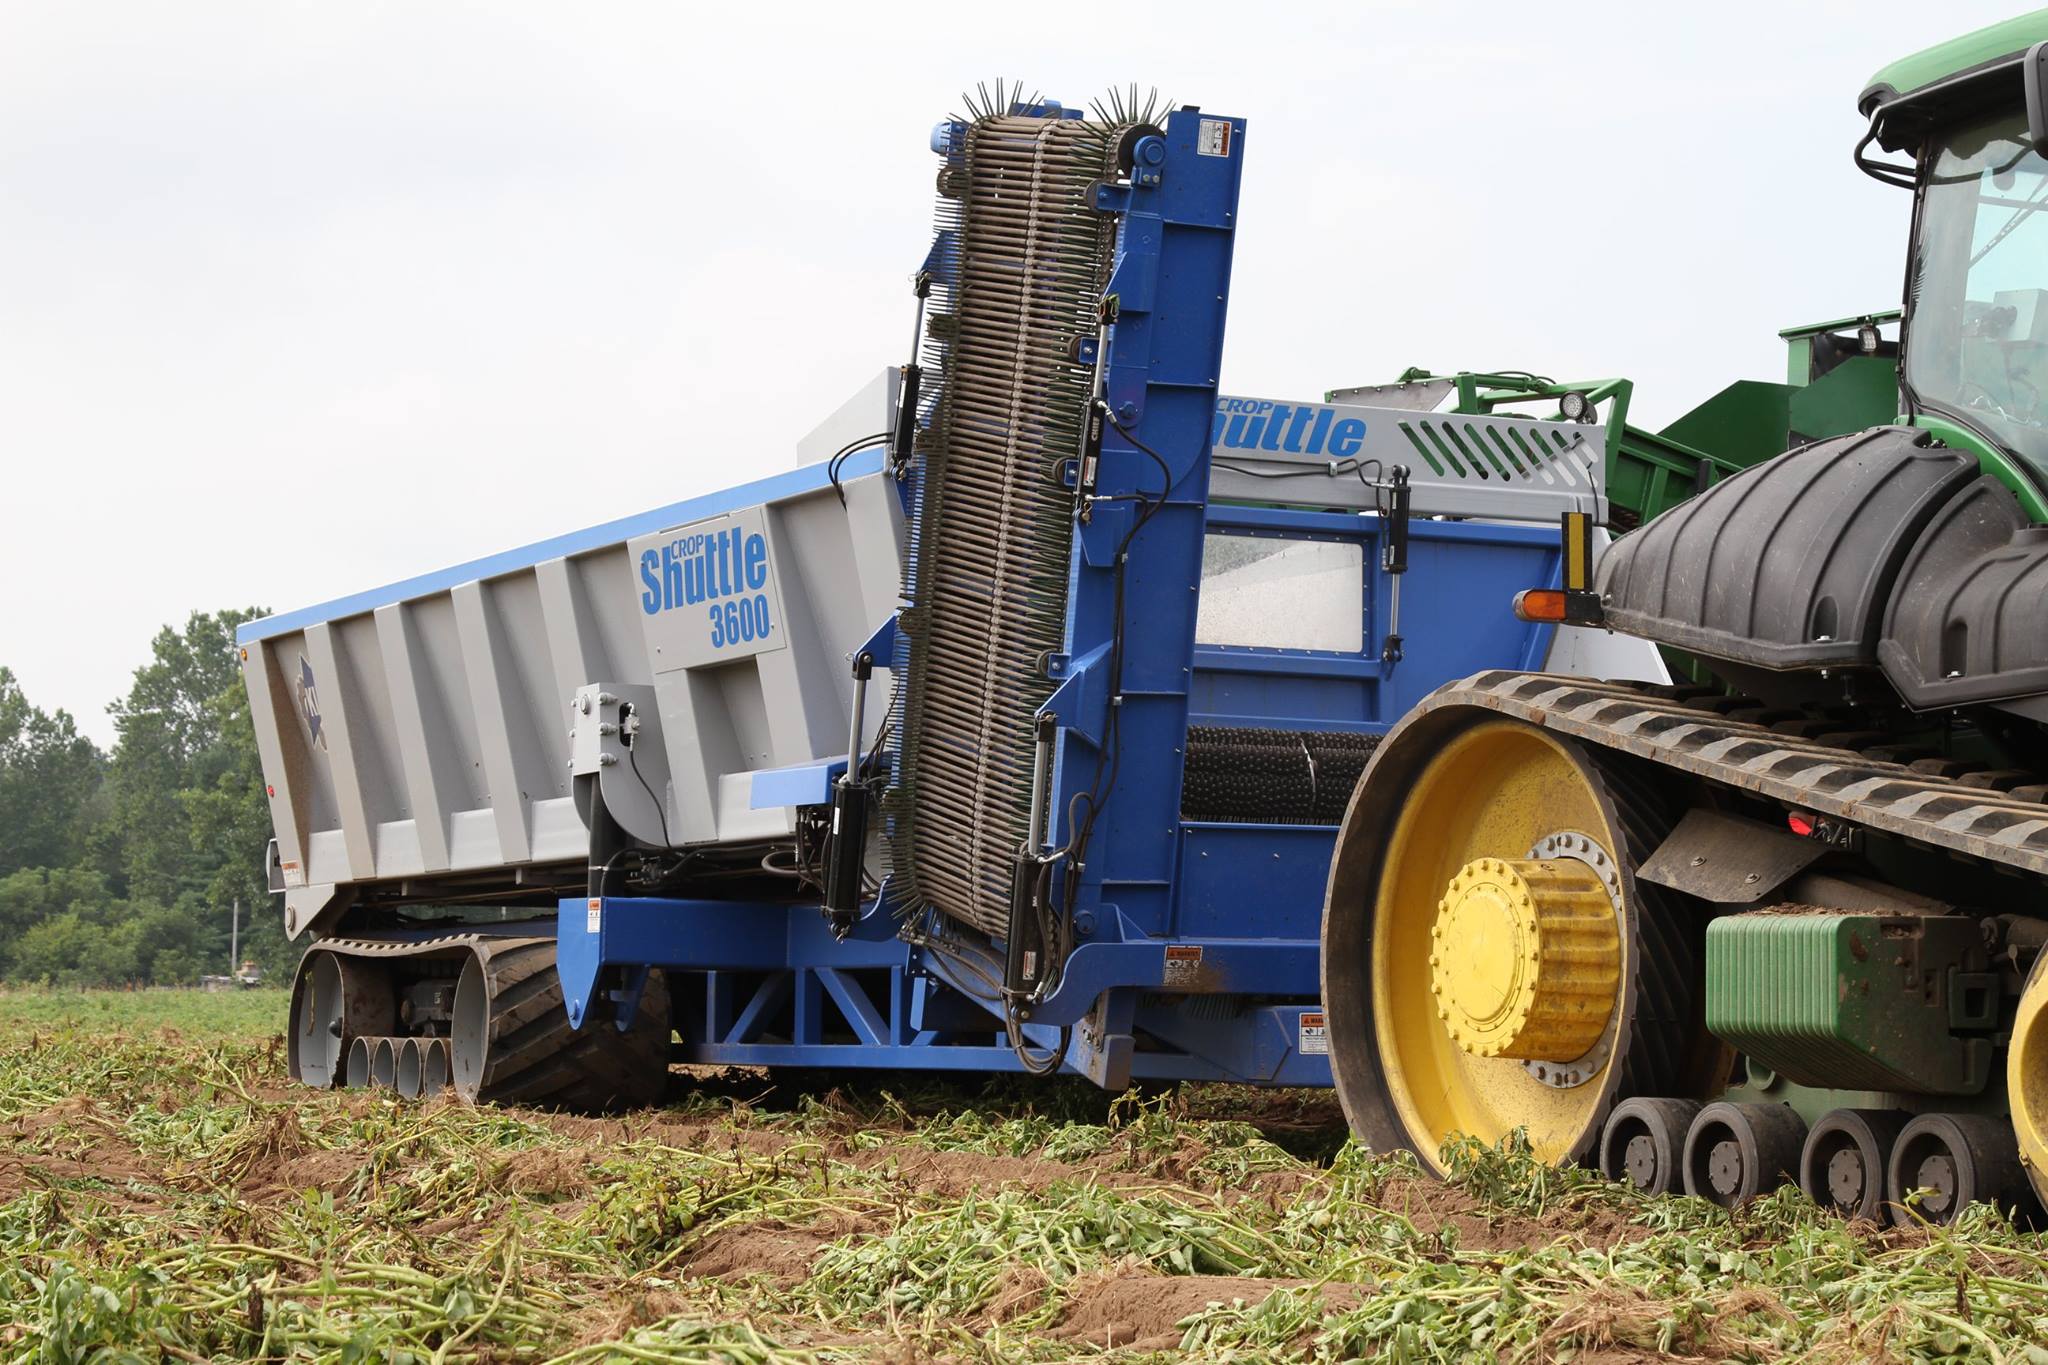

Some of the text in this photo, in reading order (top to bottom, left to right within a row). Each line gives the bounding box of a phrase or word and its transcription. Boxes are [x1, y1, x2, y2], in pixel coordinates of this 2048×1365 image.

[1212, 404, 1367, 457] uttle
[1216, 397, 1275, 414] CROP
[640, 526, 767, 616] Shuttle
[671, 534, 705, 560] CROP
[709, 593, 770, 649] 3600
